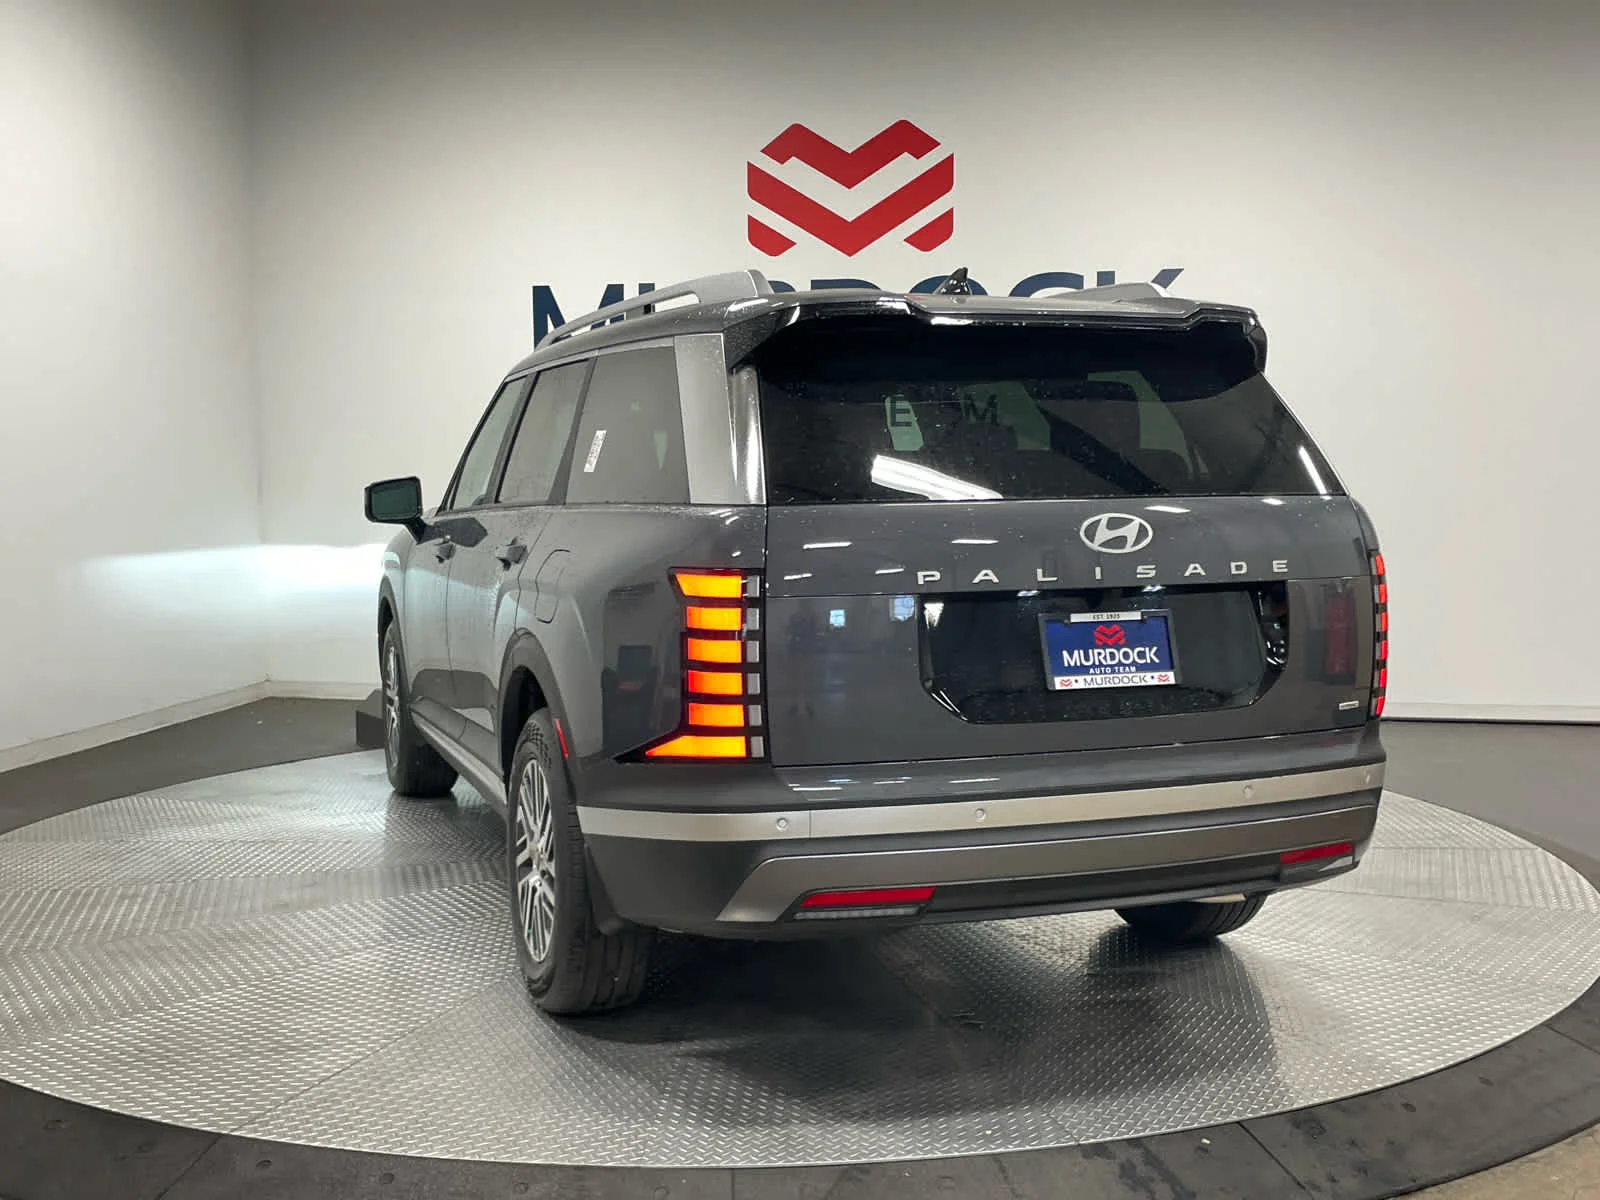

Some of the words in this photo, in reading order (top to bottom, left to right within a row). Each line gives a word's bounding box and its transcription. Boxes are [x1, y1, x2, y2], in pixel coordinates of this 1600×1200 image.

[917, 560, 1289, 585] PALISADE
[1062, 646, 1160, 667] MURDOCK
[1083, 674, 1148, 687] MURDOCK
